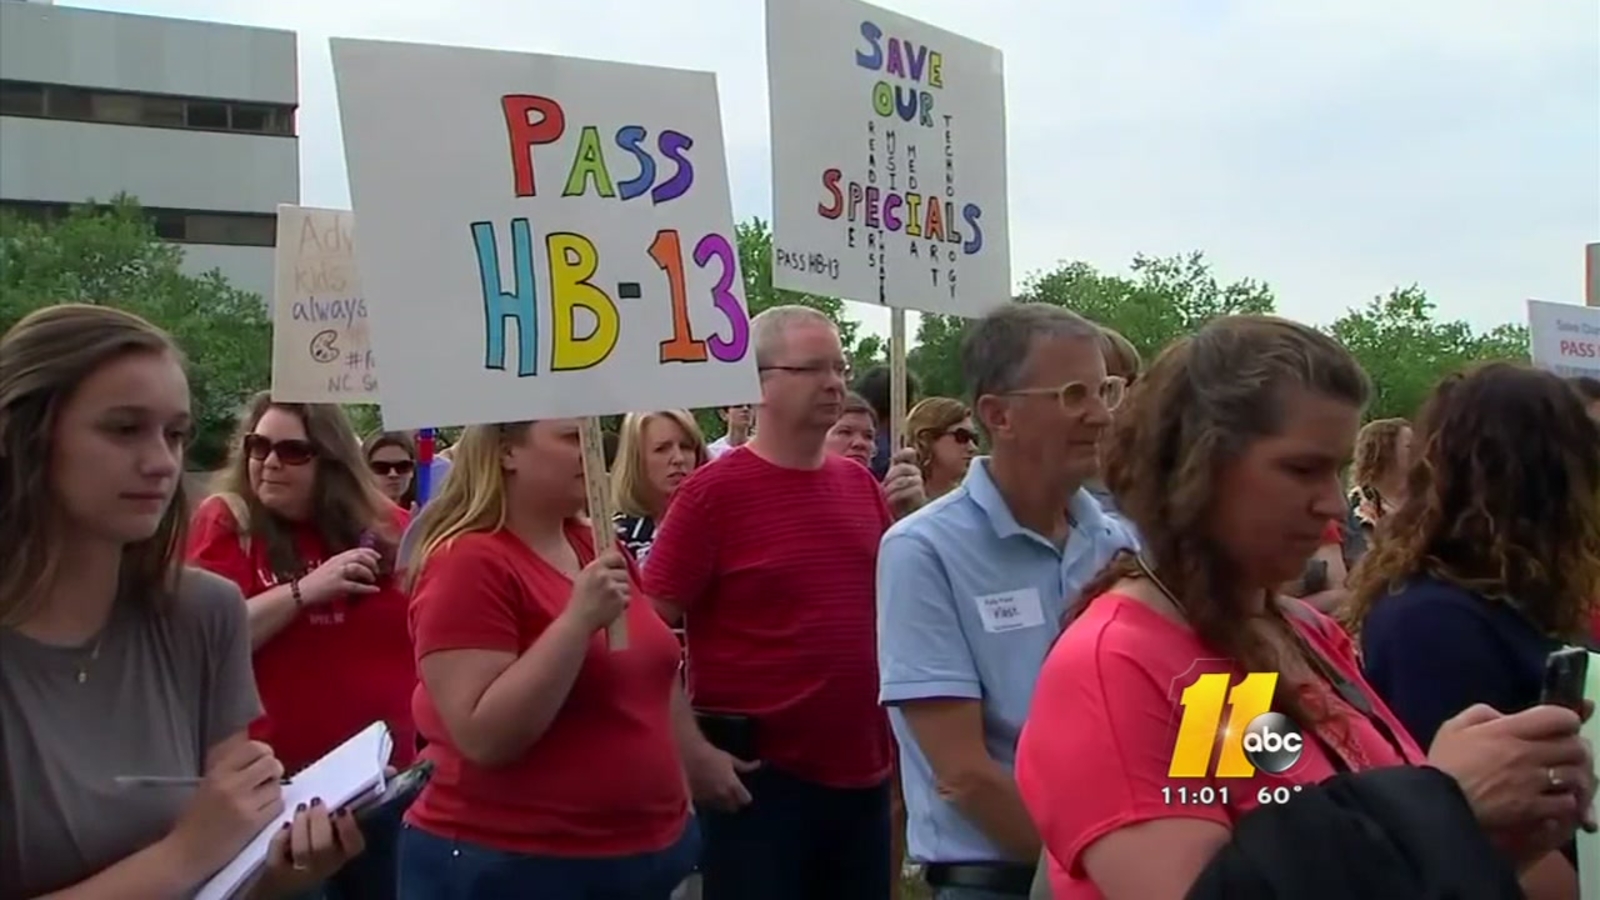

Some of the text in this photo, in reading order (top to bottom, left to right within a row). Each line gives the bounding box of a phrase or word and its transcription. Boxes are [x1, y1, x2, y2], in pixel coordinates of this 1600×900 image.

[855, 21, 943, 89] SAVE
[872, 81, 933, 127] OUR
[501, 94, 694, 206] PASS
[818, 169, 982, 254] SPECIALS
[777, 249, 839, 279] PASS HB-13
[292, 296, 368, 329] always
[470, 218, 750, 377] HB-13
[1560, 340, 1595, 358] PASS
